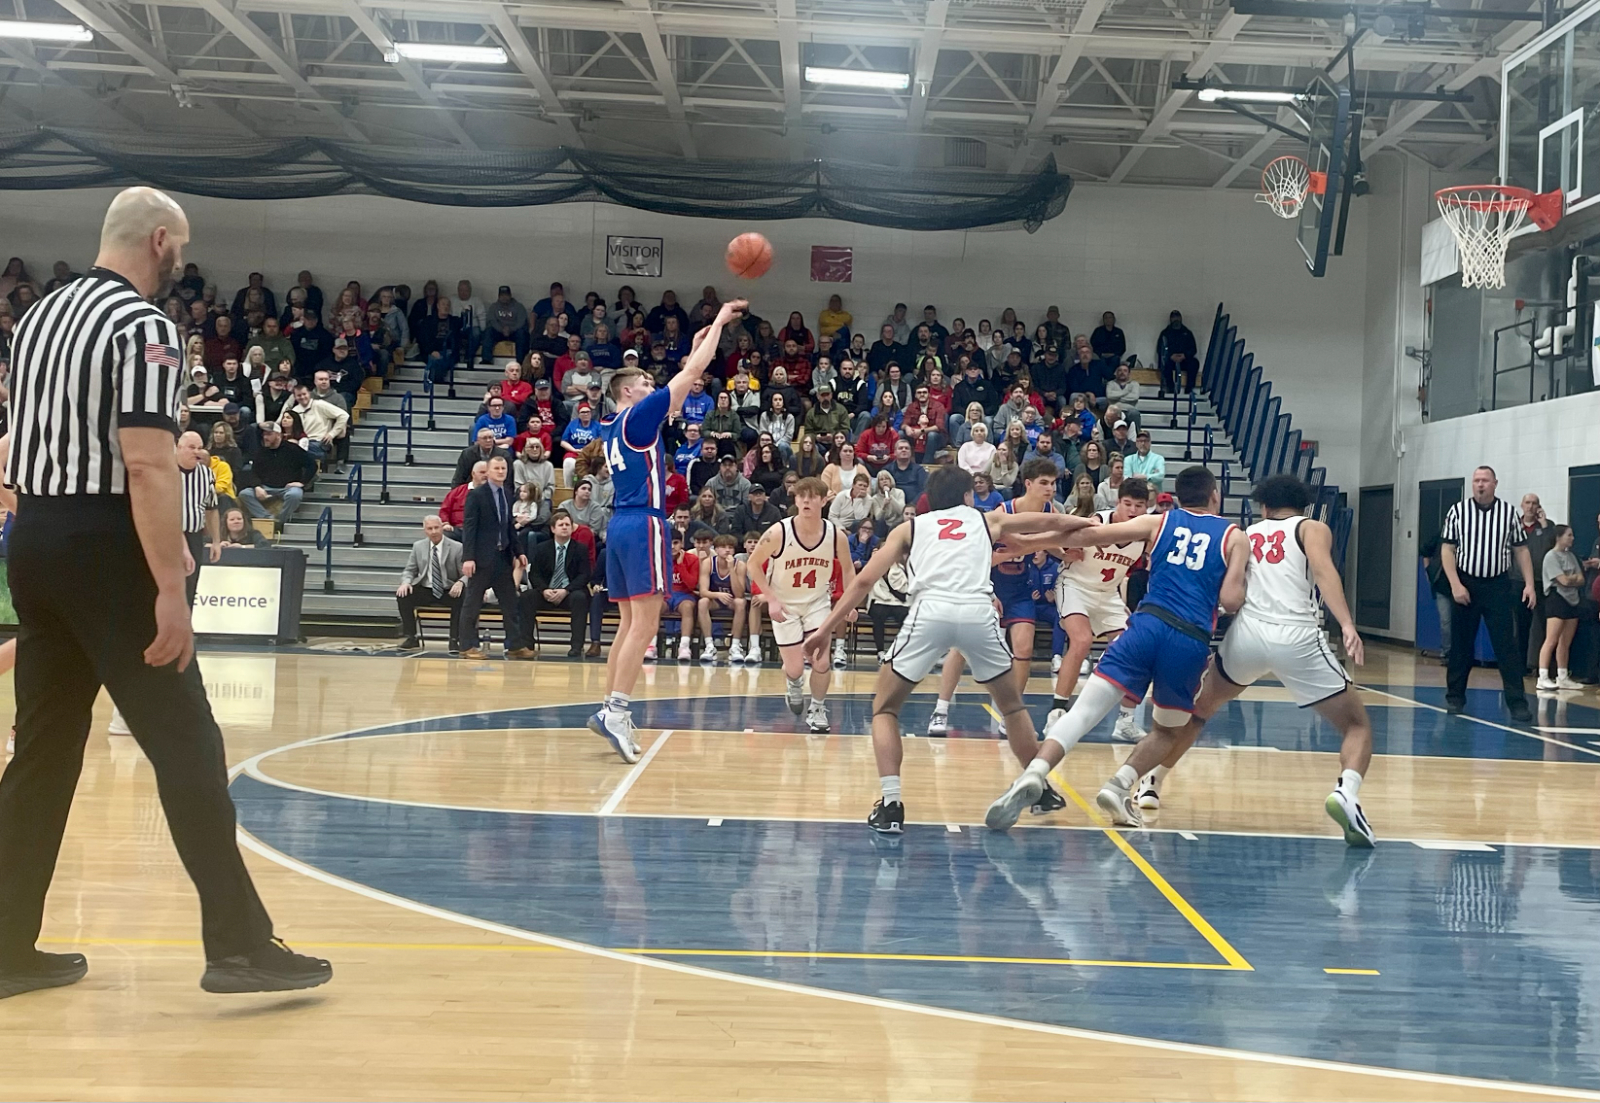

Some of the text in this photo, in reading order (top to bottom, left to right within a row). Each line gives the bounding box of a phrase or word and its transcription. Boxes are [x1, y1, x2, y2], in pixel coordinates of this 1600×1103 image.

[609, 244, 660, 258] VISITOR
[937, 518, 967, 541] 2
[1166, 526, 1211, 571] 33
[785, 557, 830, 570] PANTHERS
[792, 569, 817, 588] 14
